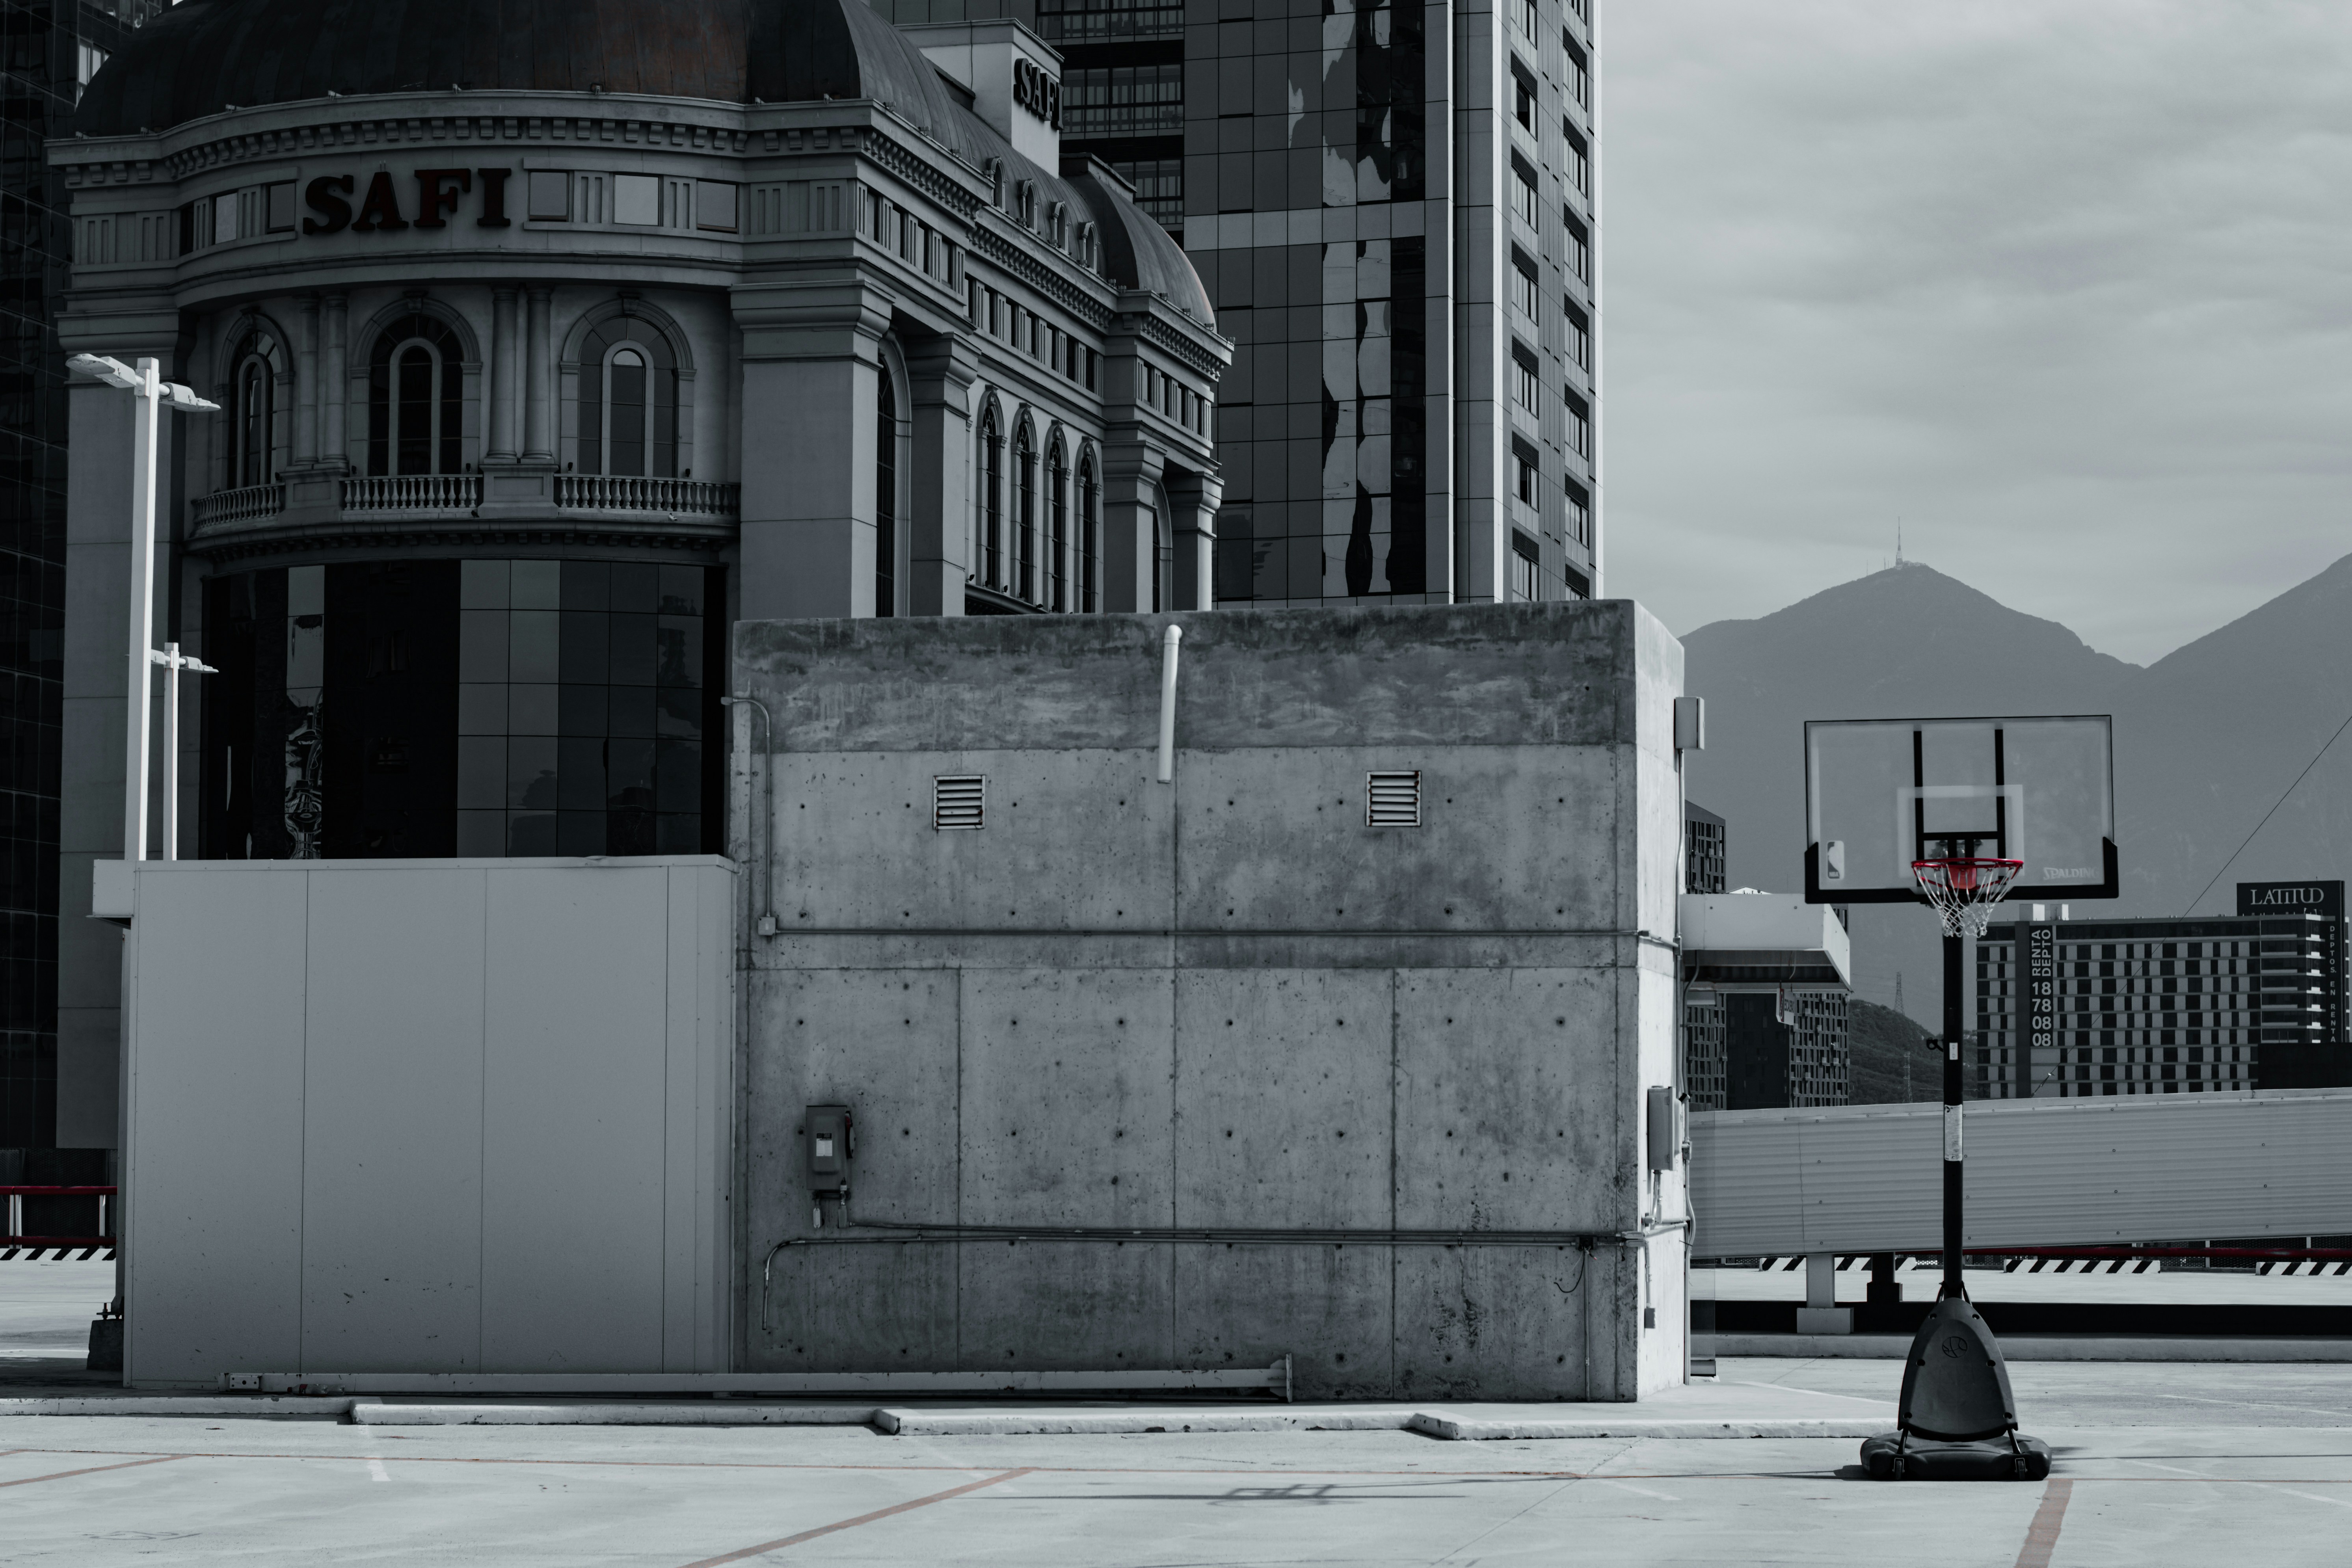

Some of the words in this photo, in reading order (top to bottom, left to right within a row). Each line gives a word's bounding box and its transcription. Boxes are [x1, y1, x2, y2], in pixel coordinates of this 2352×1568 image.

[1014, 58, 1064, 130] SAFI
[303, 168, 511, 234] SAFI
[2043, 867, 2100, 880] SPALDING
[2250, 888, 2324, 905] LATITUD
[2032, 930, 2041, 977] RENTA
[2041, 929, 2051, 977] DEPTO
[2032, 982, 2051, 995] 18
[2330, 981, 2335, 996] EN
[2032, 998, 2052, 1012] 78
[2032, 1016, 2052, 1030] 08
[2032, 1032, 2051, 1047] 08
